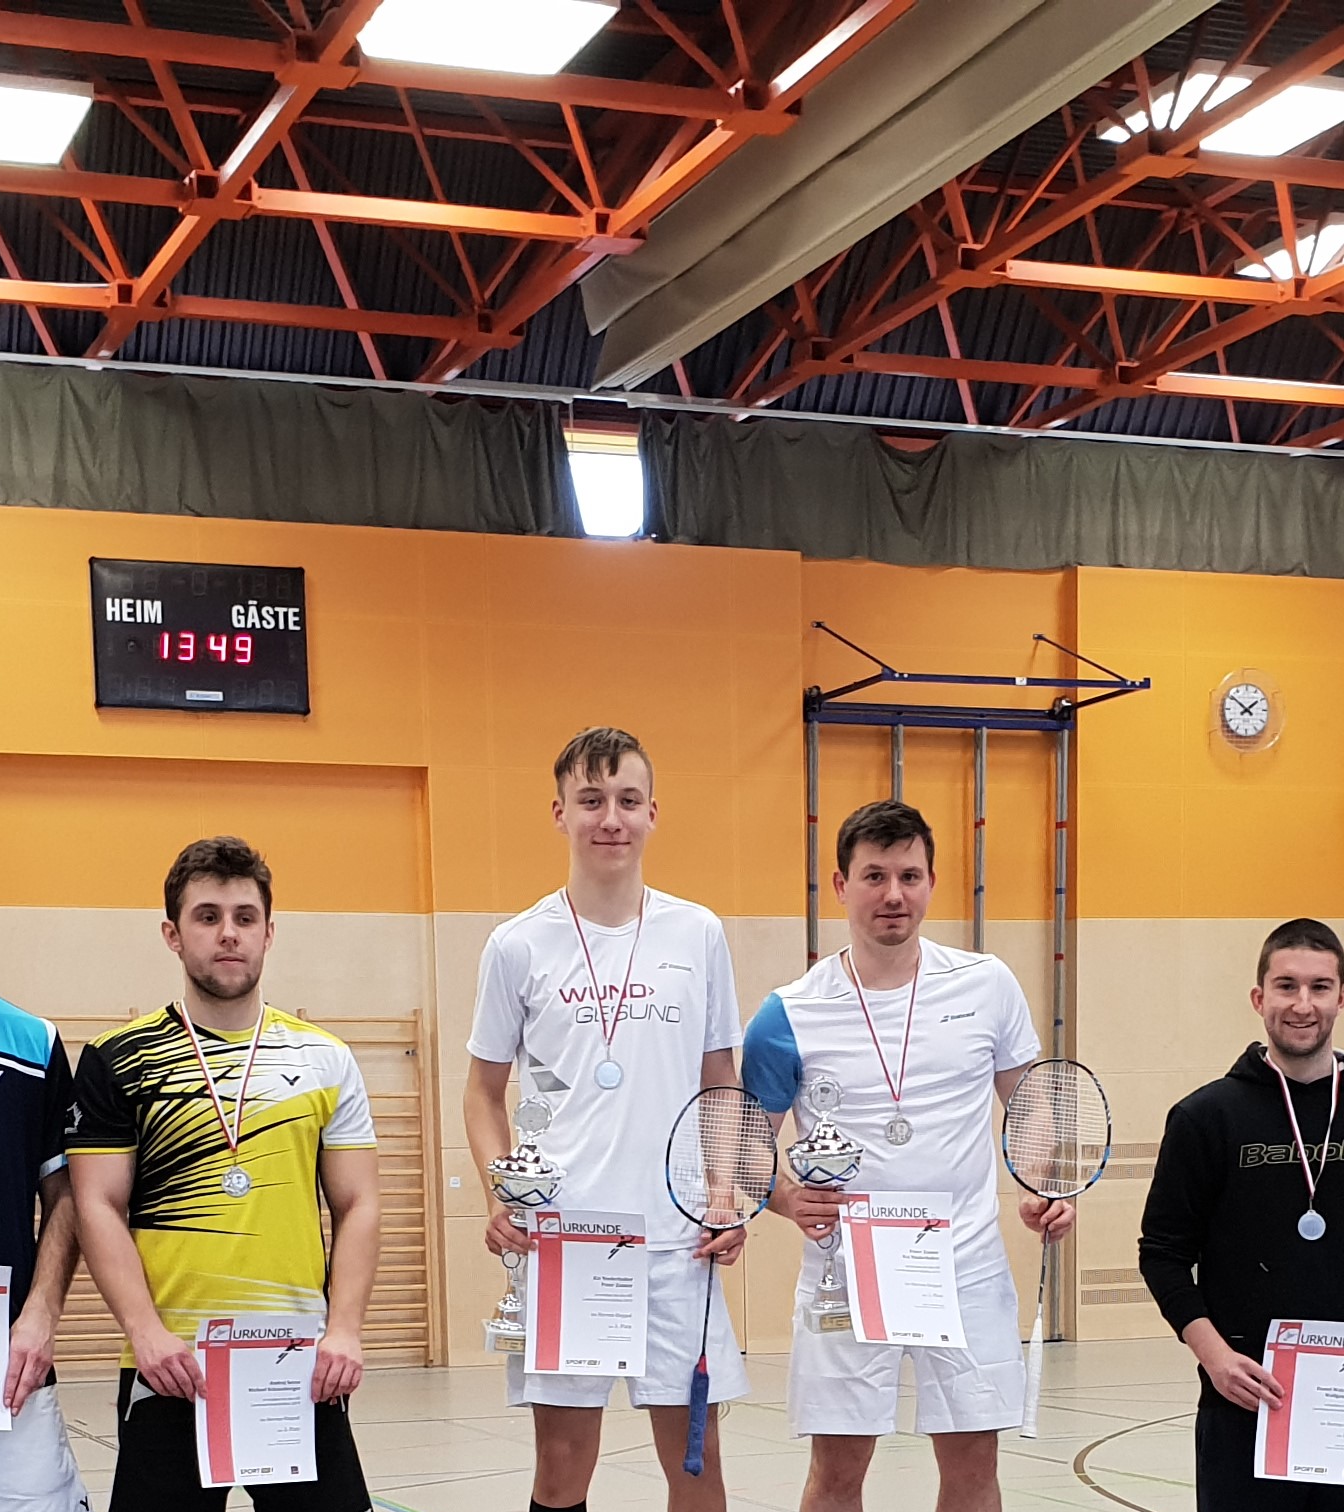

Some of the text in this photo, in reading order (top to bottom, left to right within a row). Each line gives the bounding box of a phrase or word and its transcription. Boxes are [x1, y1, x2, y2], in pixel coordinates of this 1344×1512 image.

[106, 598, 301, 631] HEIM GÄSTE
[576, 1004, 681, 1024] GESUND
[871, 1207, 929, 1218] URKUNDE
[563, 1222, 622, 1234] URKUNDE
[232, 1328, 294, 1339] URKUNDE
